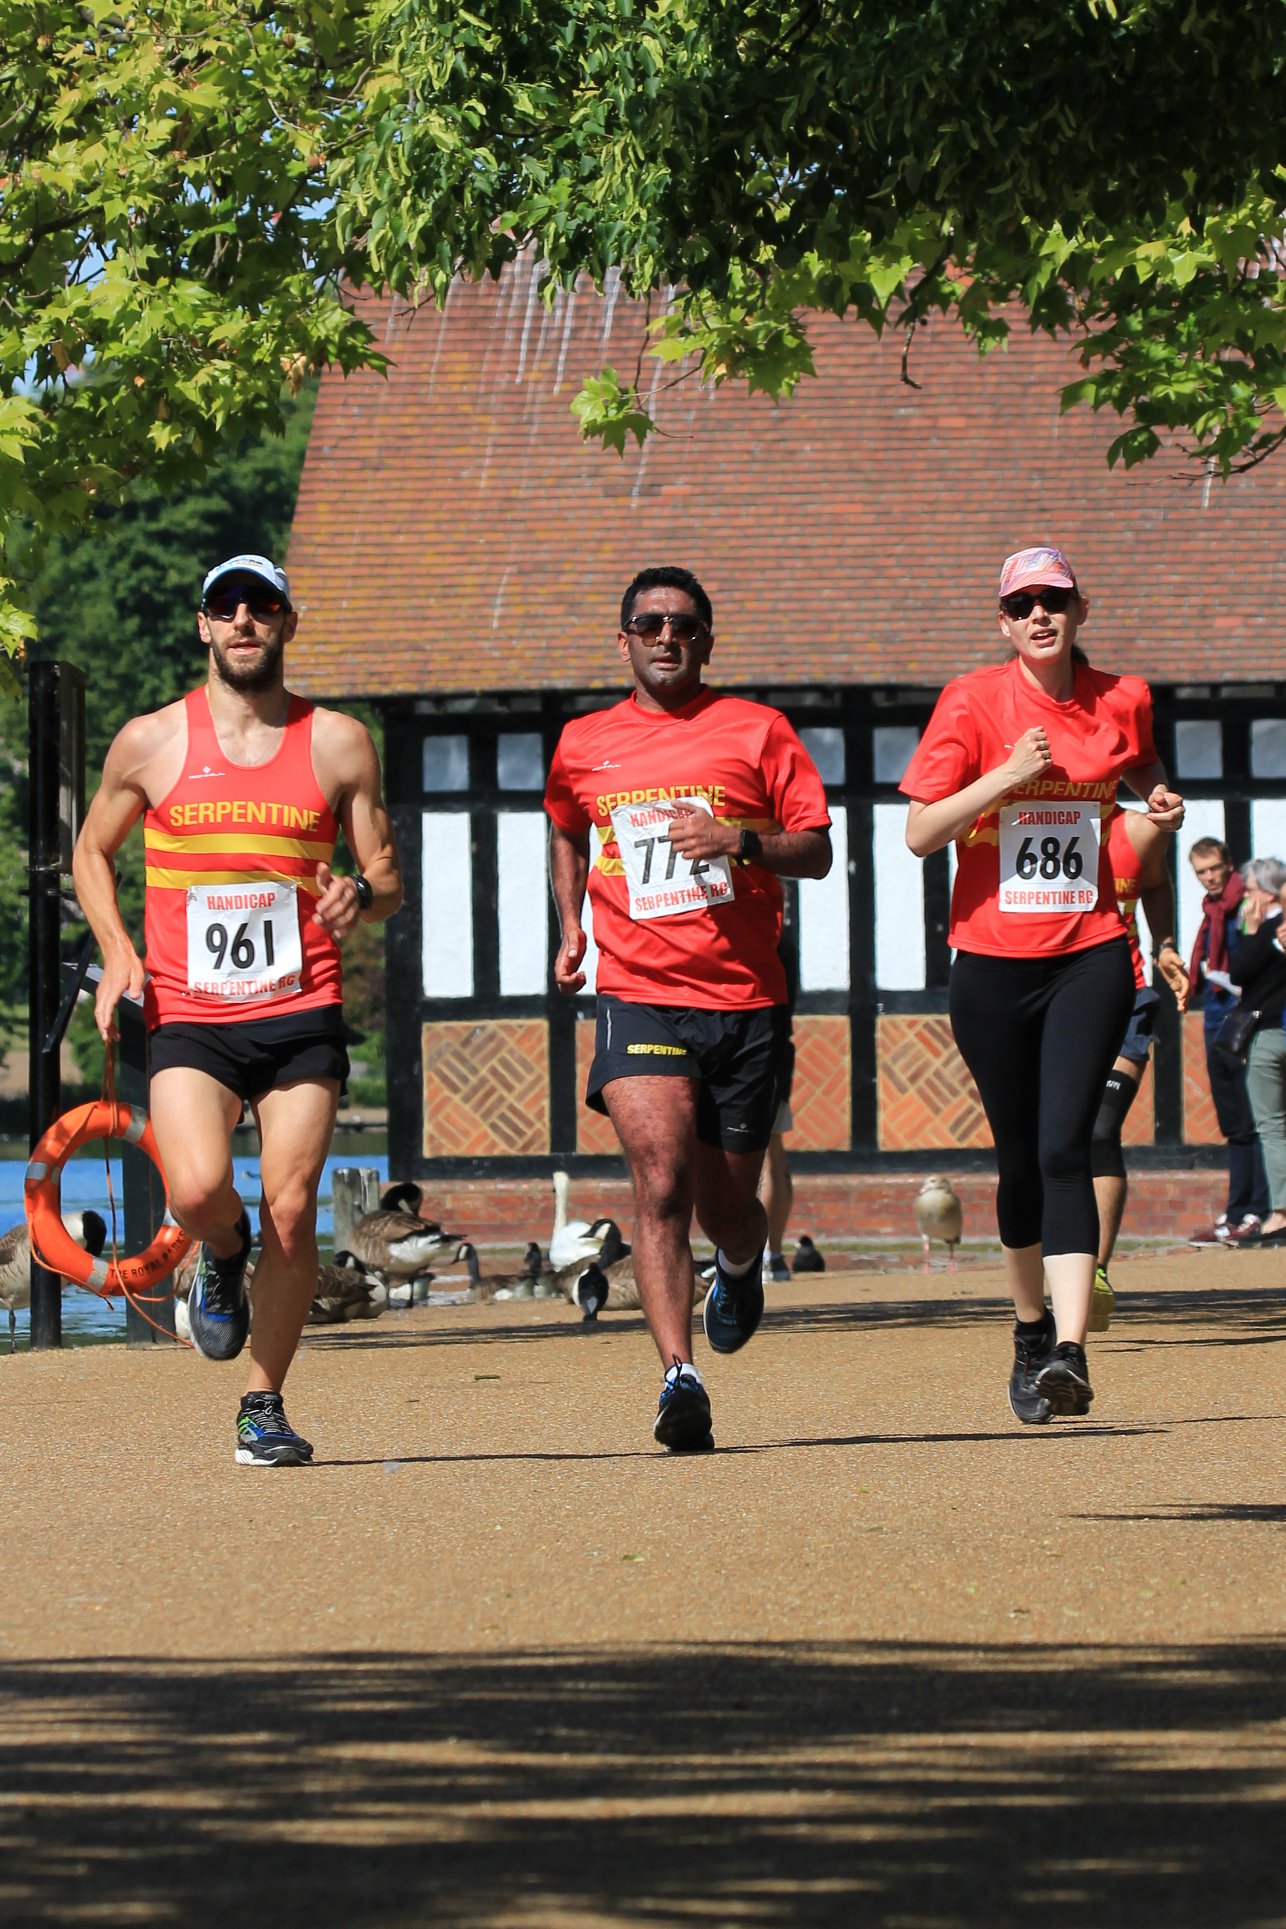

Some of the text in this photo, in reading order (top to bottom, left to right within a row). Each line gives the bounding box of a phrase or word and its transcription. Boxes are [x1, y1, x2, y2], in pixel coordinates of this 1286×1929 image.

[1011, 779, 1117, 799] ERPENTINE
[169, 800, 321, 832] SERPENTINE
[1018, 811, 1081, 825] HANDICAP
[1016, 836, 1083, 880] 686
[207, 892, 276, 911] HANDICAP
[635, 885, 708, 912] SERPENTINE
[1005, 890, 1075, 905] SERPENTINE
[205, 919, 275, 970] 961
[194, 979, 276, 996] SERPENTINE
